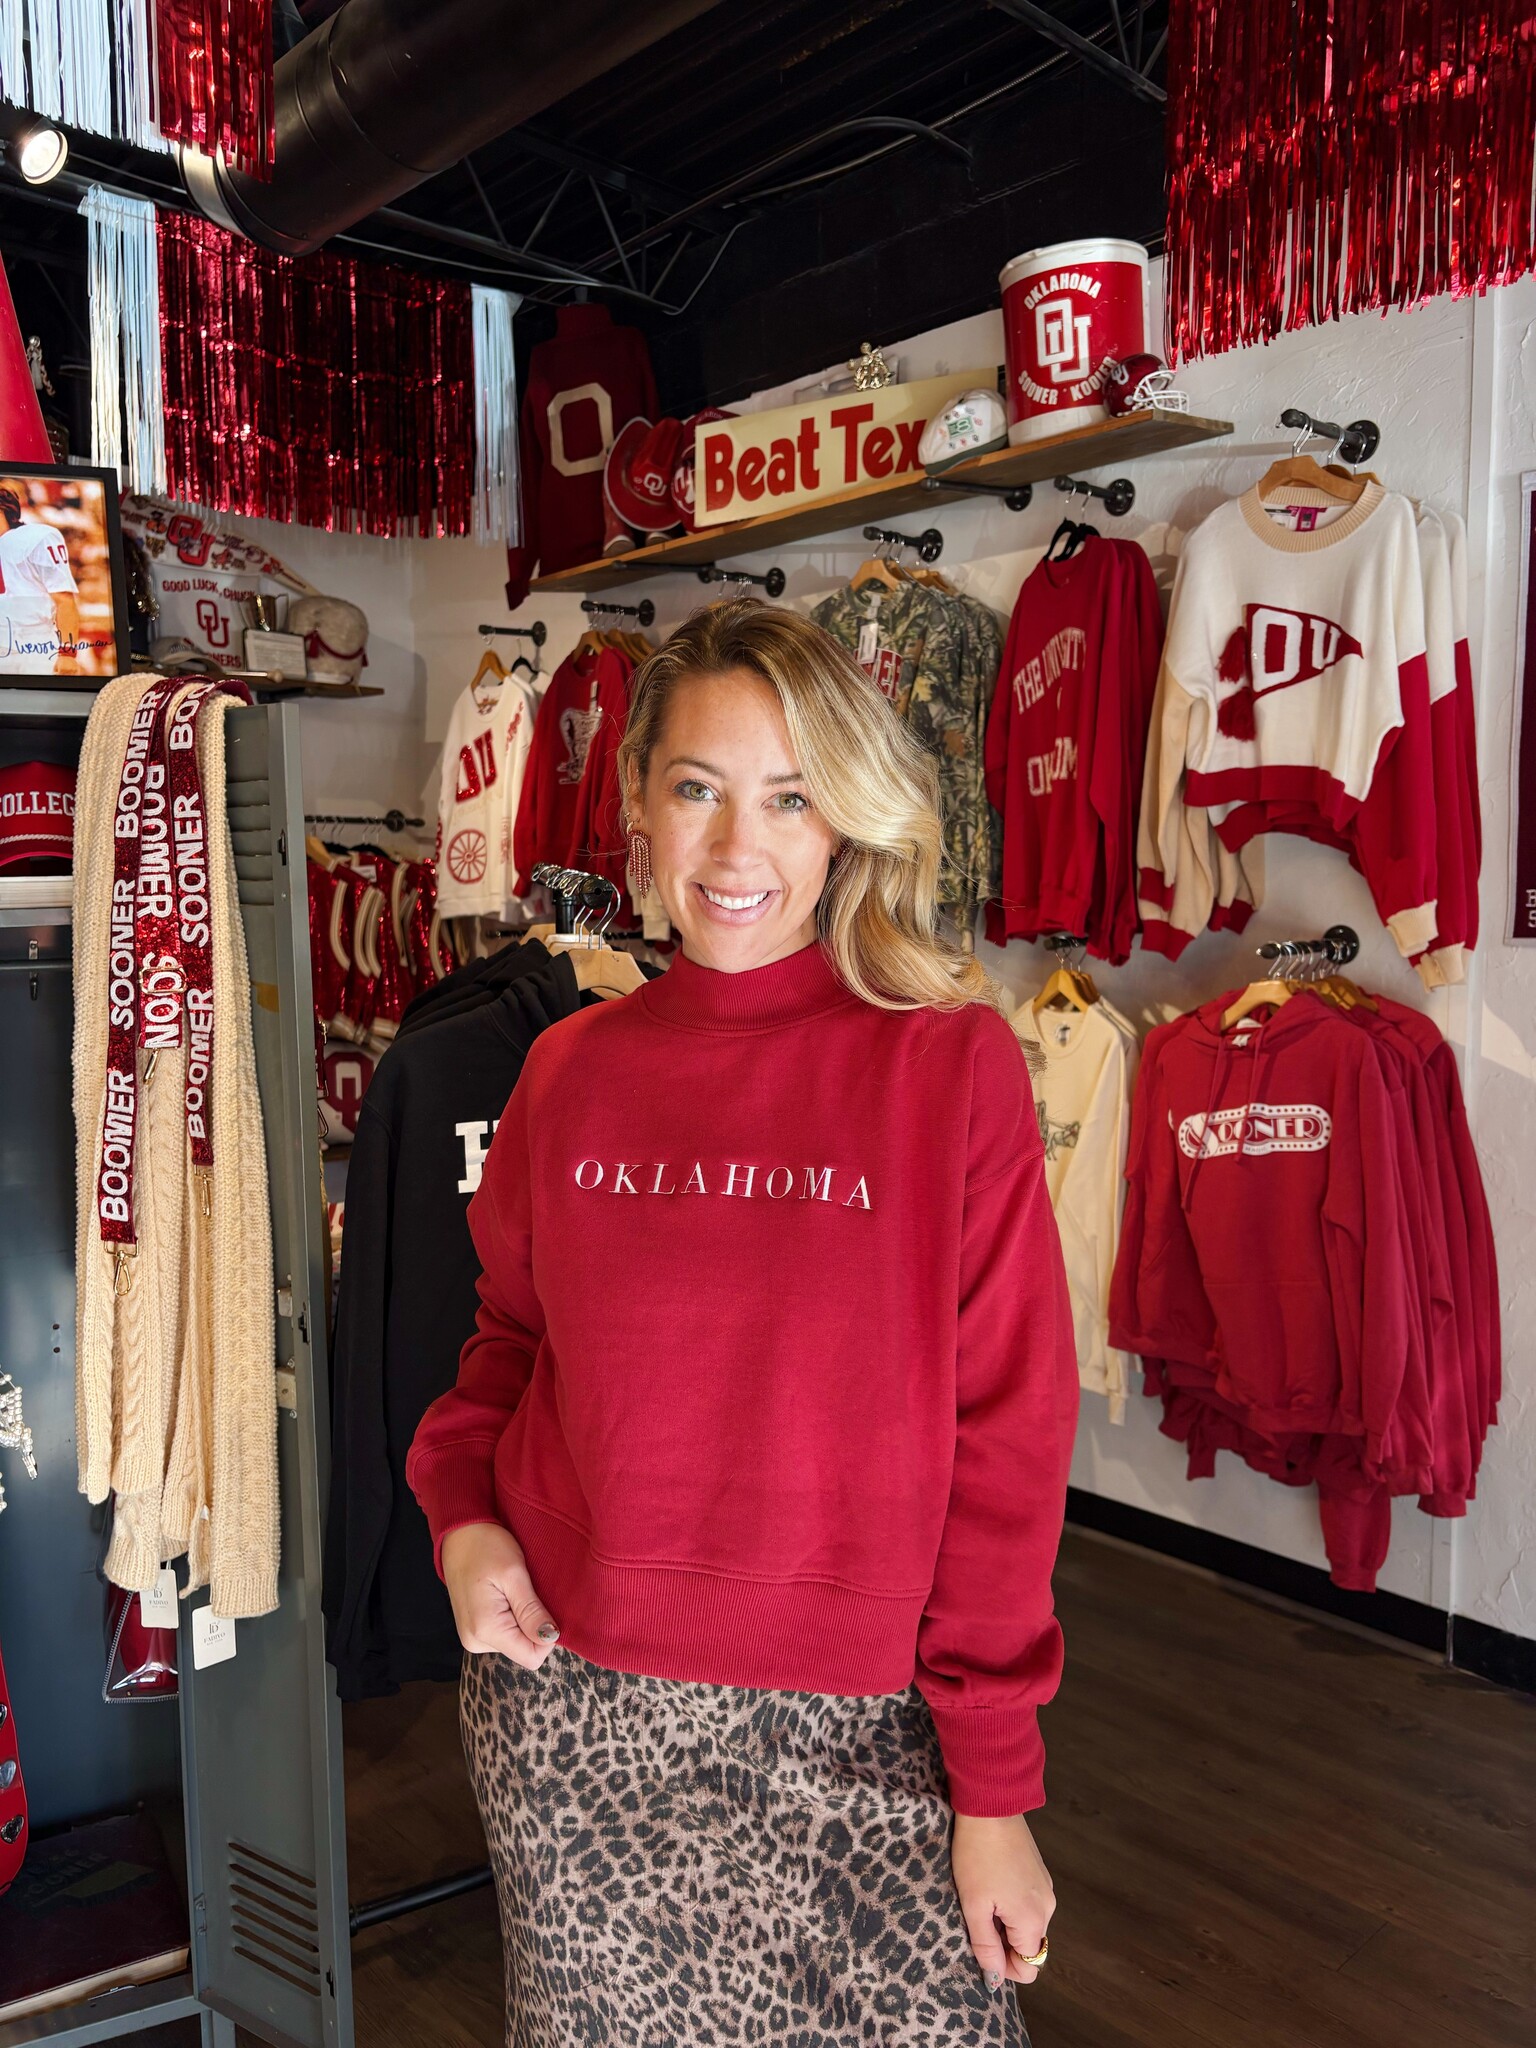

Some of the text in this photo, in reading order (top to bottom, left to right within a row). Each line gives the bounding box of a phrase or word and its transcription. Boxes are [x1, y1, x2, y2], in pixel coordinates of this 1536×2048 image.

[1023, 272, 1102, 311] OKLAHOMA
[1035, 297, 1092, 385] OU
[1018, 369, 1058, 405] SOONER
[1111, 364, 1129, 386] OU
[547, 382, 614, 477] O
[704, 416, 820, 513] Beat
[830, 402, 928, 485] Tex
[643, 472, 667, 497] OU
[47, 544, 68, 565] 10
[162, 580, 191, 593] GOOD
[196, 599, 230, 648] OU
[1251, 607, 1342, 693] OU
[1012, 656, 1045, 715] THE
[136, 764, 174, 918] BOOMER
[173, 792, 210, 947] SOONER
[100, 690, 164, 1222] BOOMER SOONER BOOMER
[186, 987, 214, 1139] BOOMER
[574, 1158, 874, 1211] OKLAHOMA
